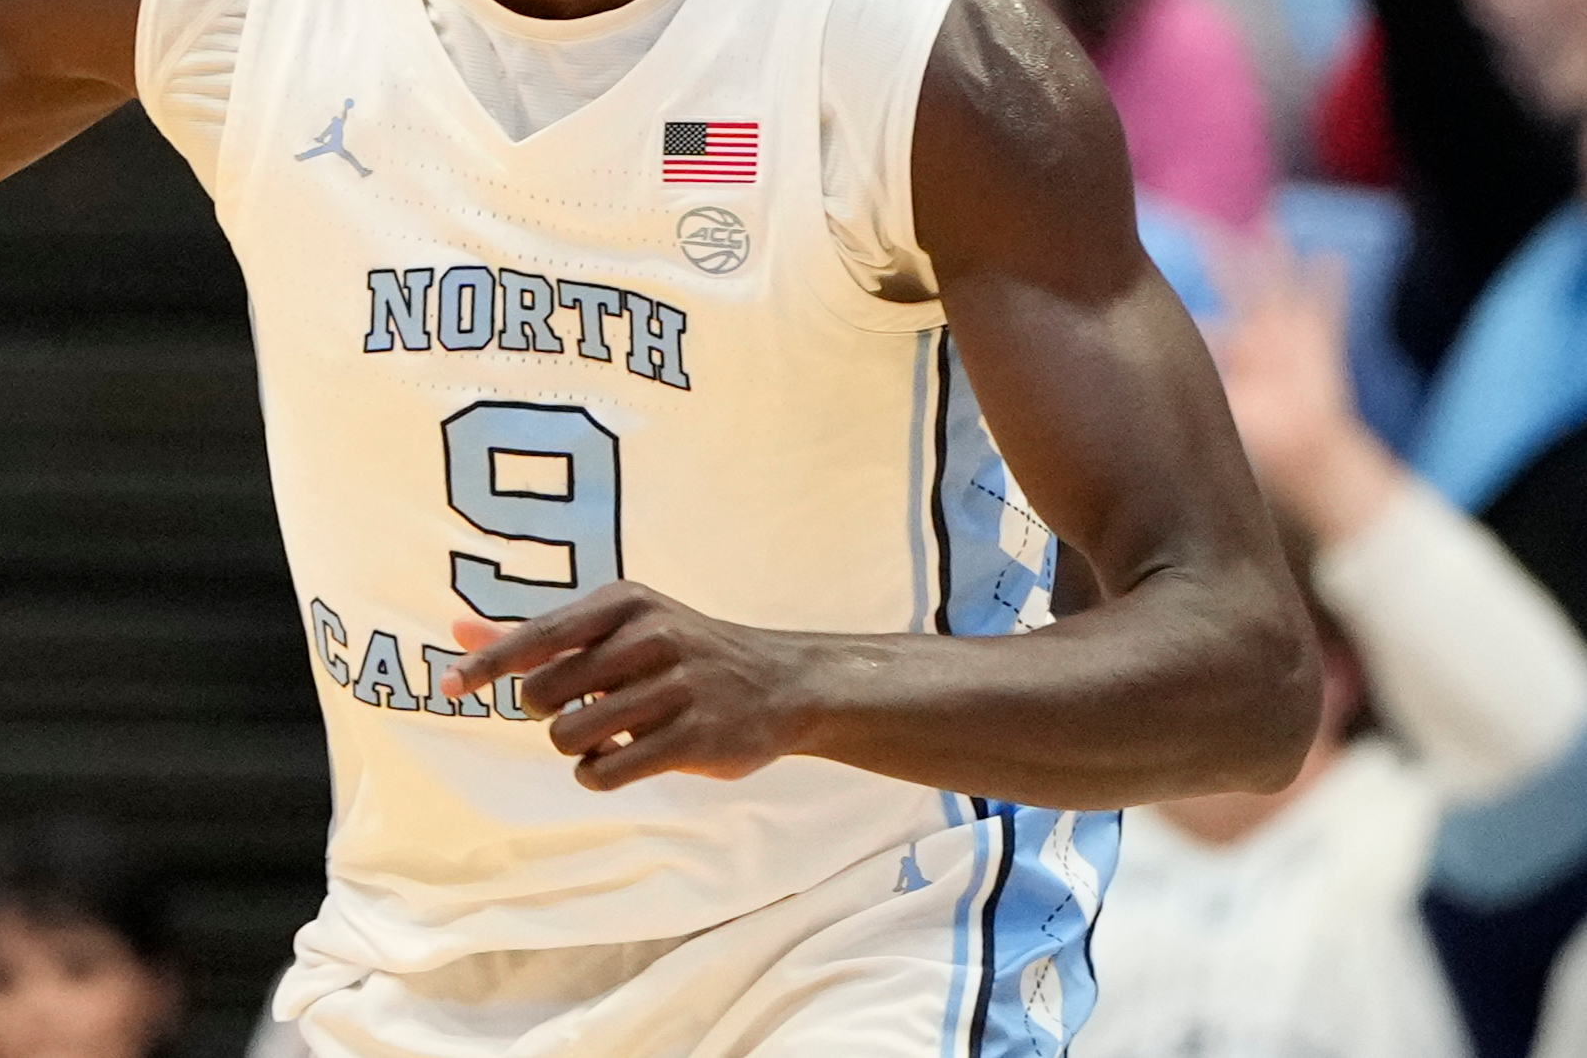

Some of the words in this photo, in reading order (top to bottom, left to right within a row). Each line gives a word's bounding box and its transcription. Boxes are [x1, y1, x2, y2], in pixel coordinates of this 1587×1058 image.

[685, 226, 747, 249] ACC
[363, 265, 691, 391] NORTH
[440, 400, 624, 622] 9
